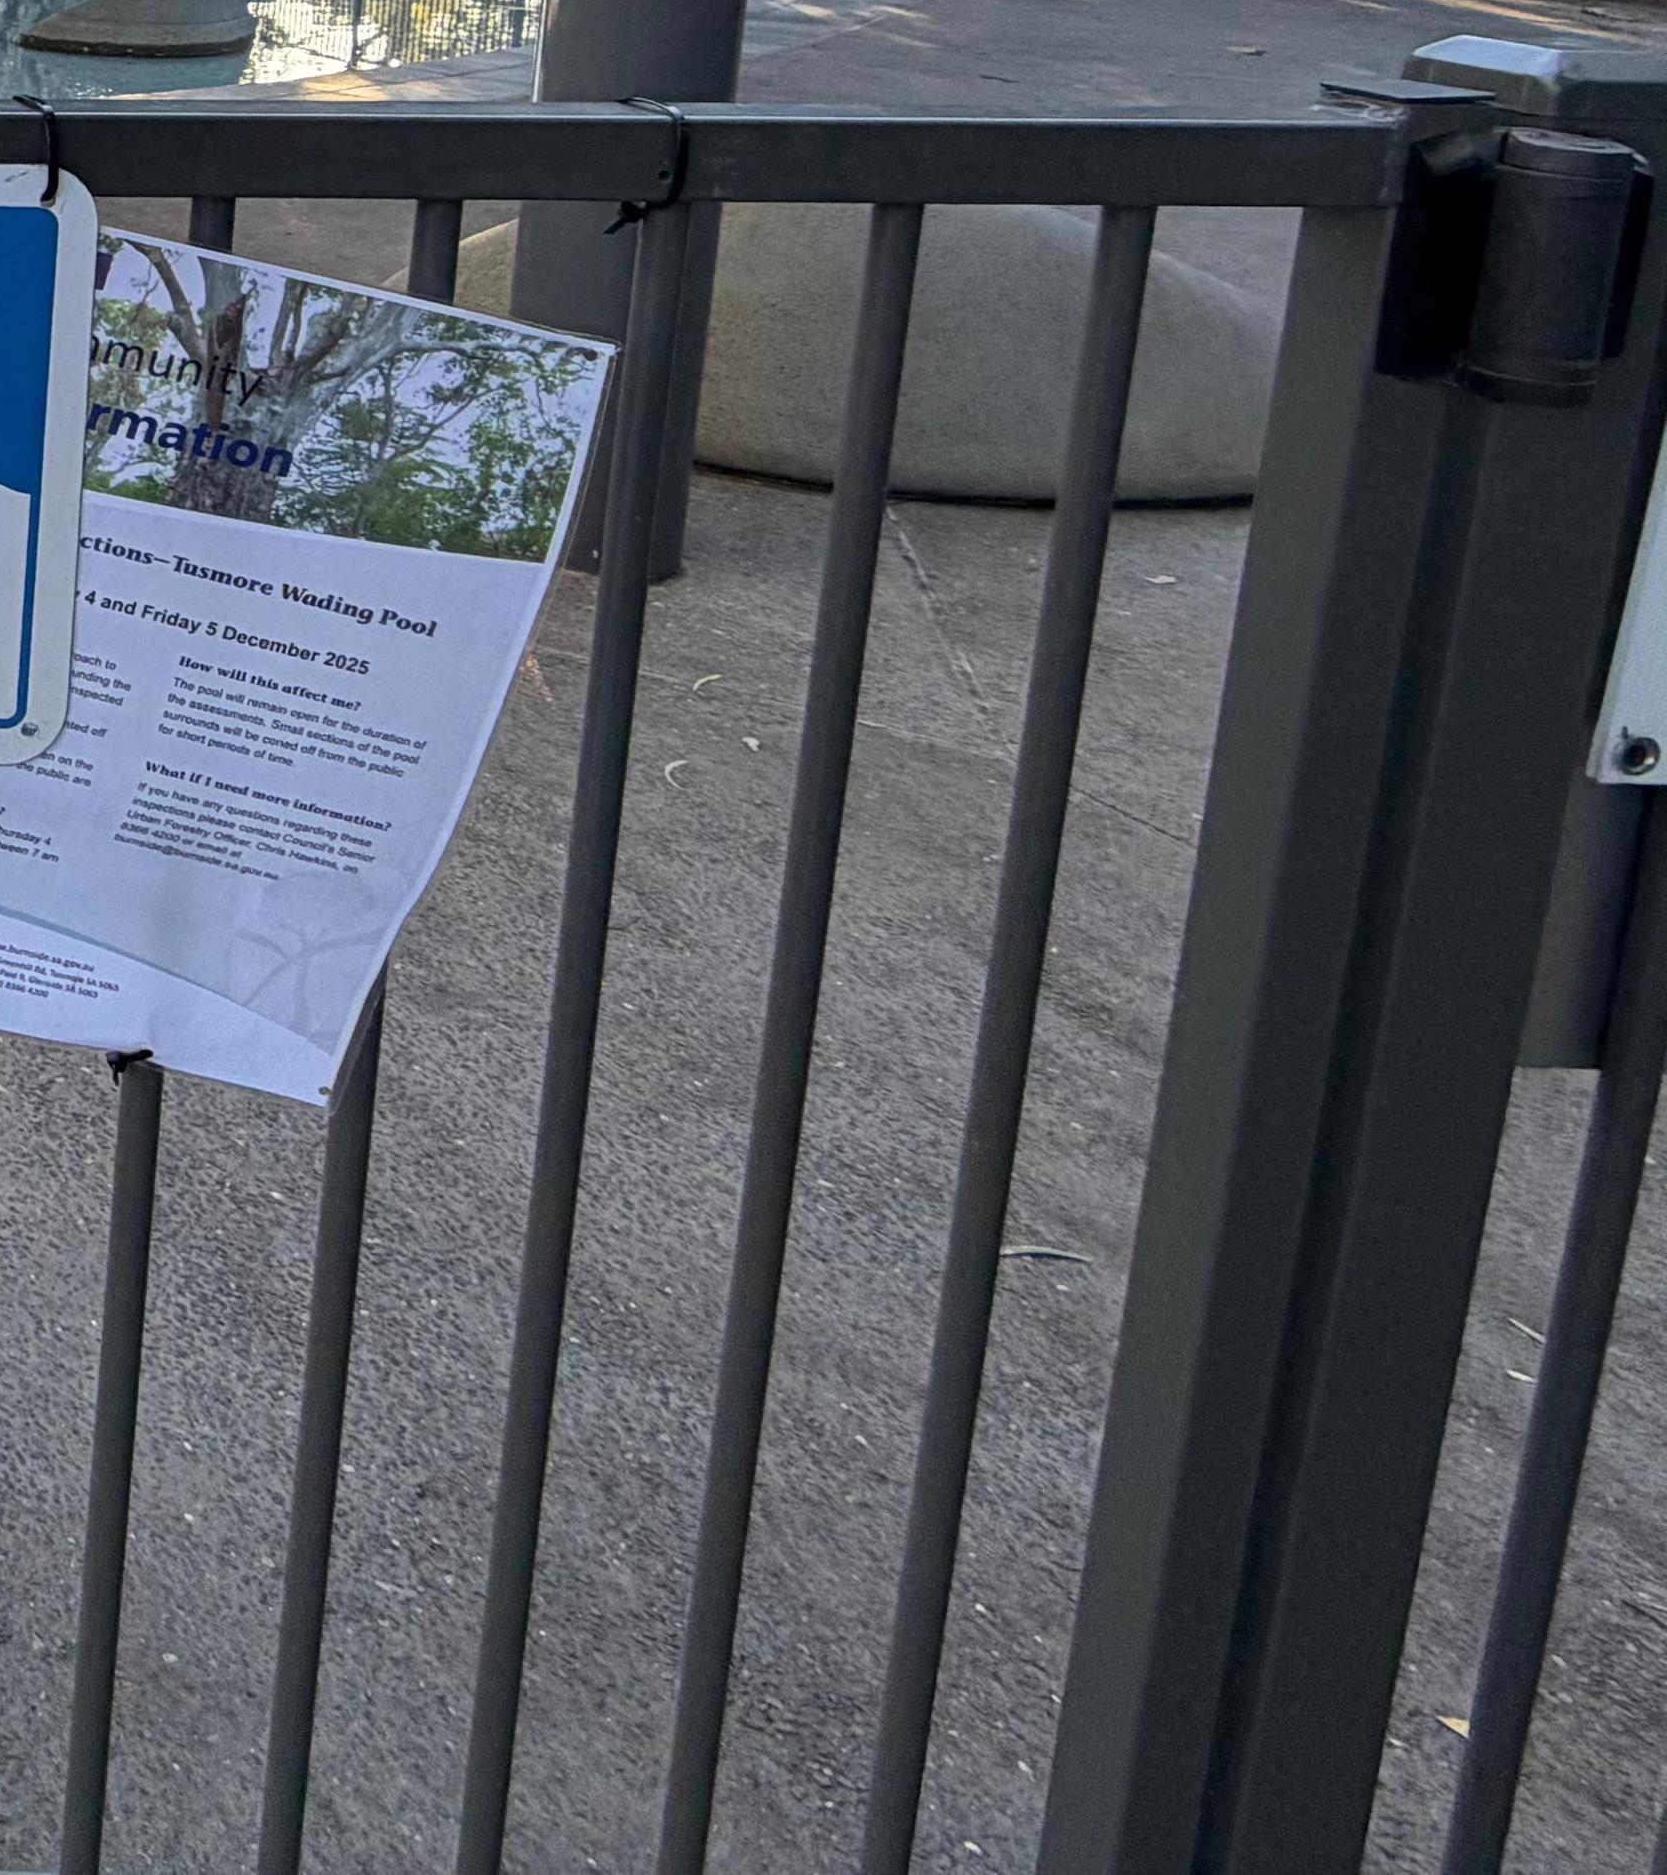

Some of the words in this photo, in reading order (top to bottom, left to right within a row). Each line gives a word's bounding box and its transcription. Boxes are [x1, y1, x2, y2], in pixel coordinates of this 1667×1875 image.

[90, 333, 264, 407] munity
[87, 402, 294, 478] rmation
[84, 590, 97, 605] 4
[100, 597, 138, 616] and
[140, 604, 202, 635] Friday
[205, 621, 219, 637] 5
[221, 625, 321, 662] December
[322, 651, 371, 675] 2025
[282, 583, 374, 625] Wading
[378, 608, 438, 638] Pool
